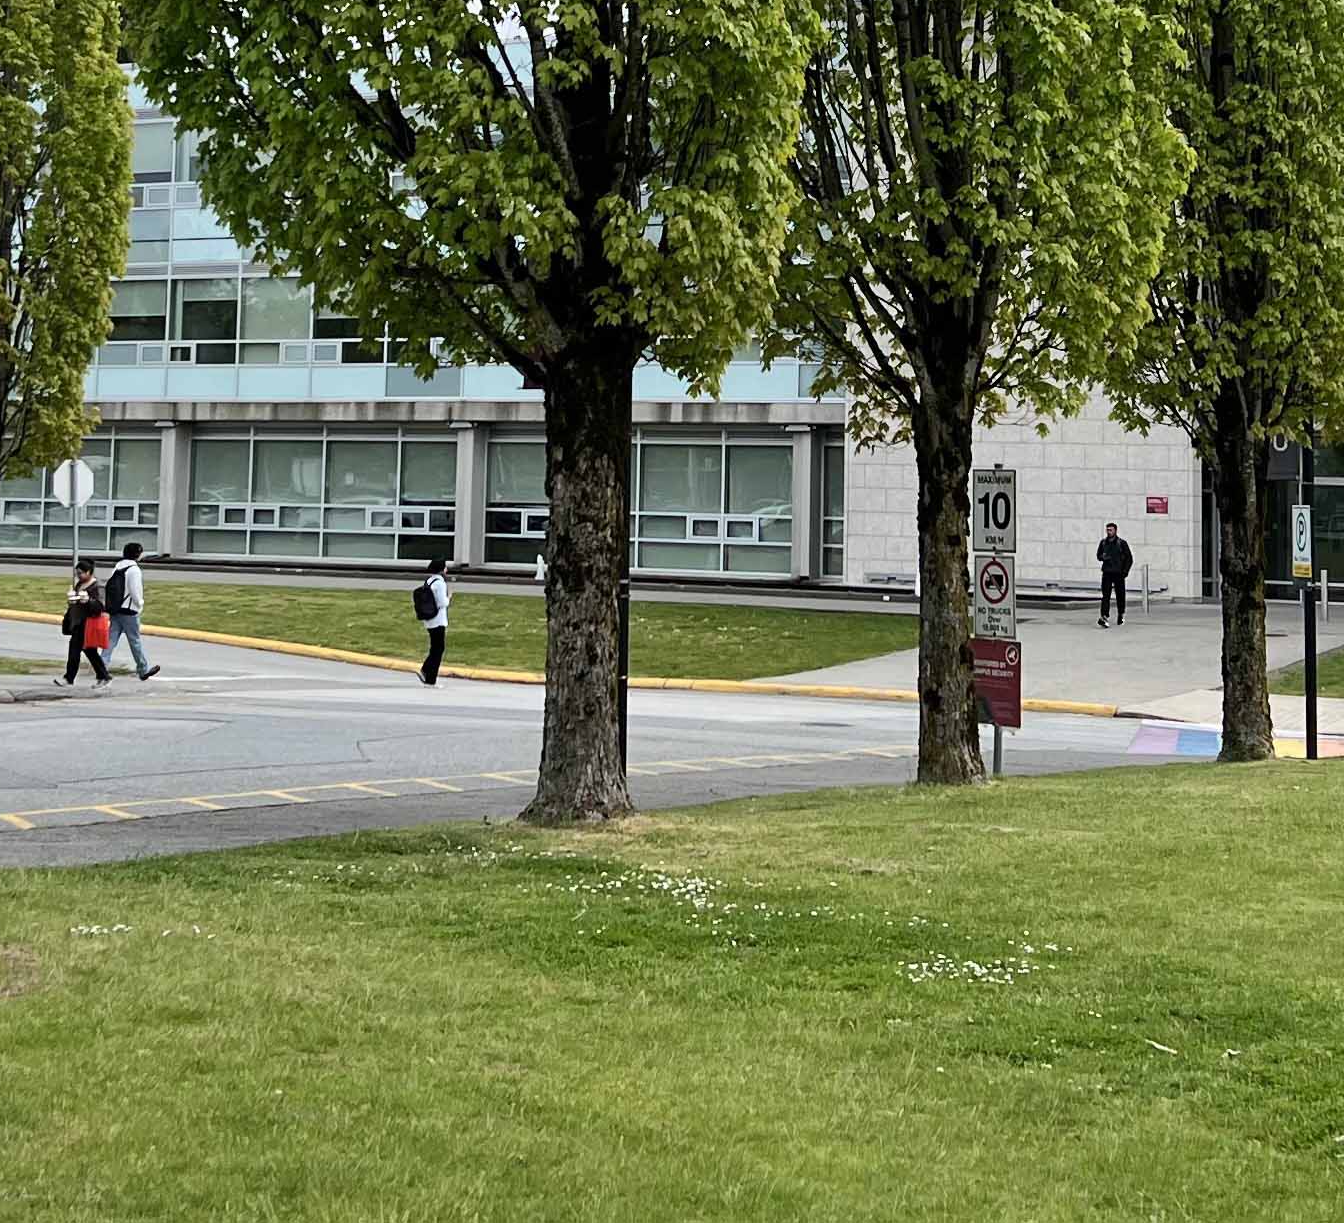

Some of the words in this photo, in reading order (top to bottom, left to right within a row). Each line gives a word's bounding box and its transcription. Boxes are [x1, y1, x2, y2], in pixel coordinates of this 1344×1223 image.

[977, 475, 1012, 485] MAXIMUM
[978, 491, 1011, 530] 10
[988, 607, 1011, 615] TRUCKS
